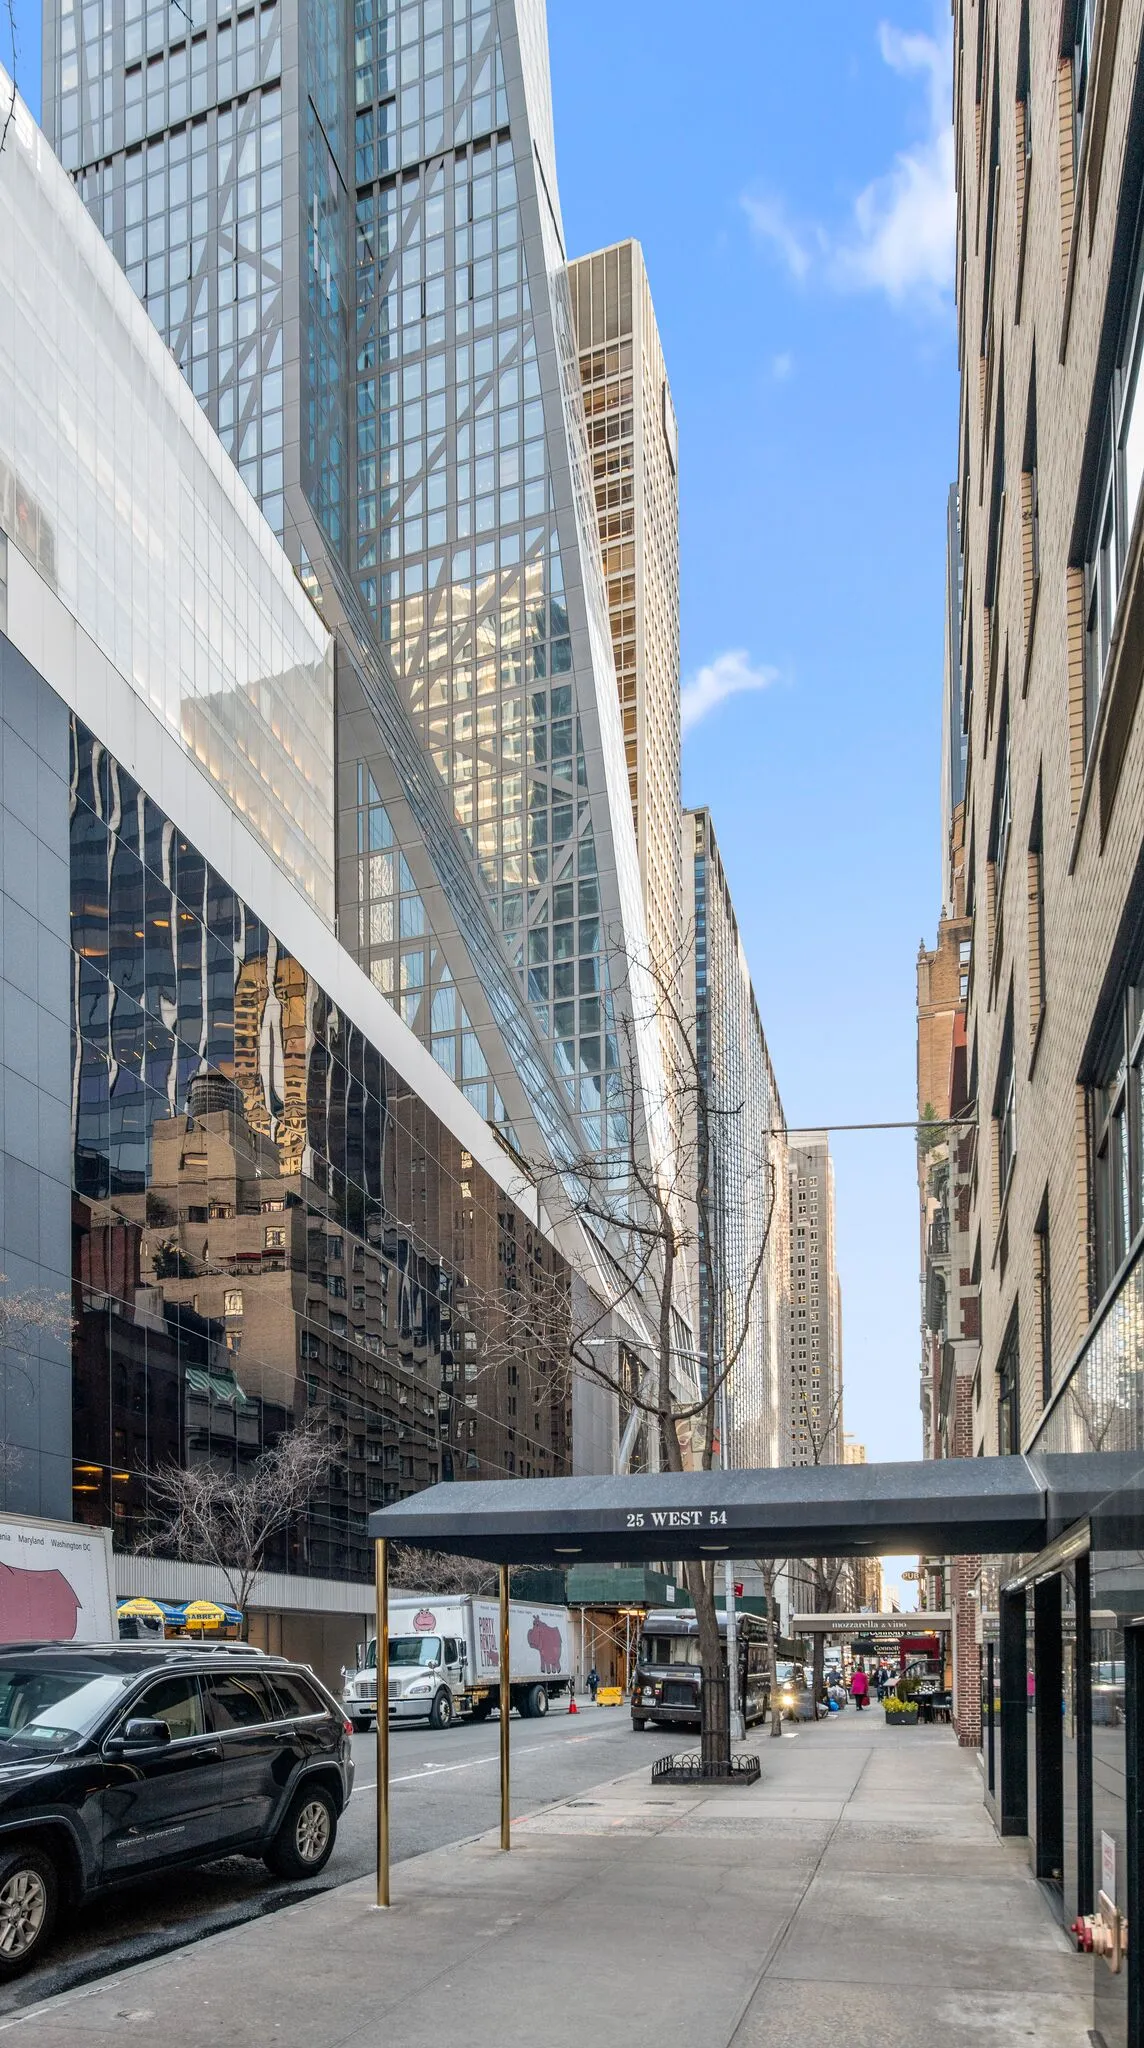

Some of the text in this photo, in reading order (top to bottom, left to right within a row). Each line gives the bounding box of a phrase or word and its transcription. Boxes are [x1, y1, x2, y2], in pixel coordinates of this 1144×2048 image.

[626, 1510, 728, 1527] 25 WEST 54
[18, 1534, 45, 1546] Maryland
[50, 1538, 82, 1551] Washington
[82, 1543, 91, 1551] DC
[832, 1620, 879, 1629] mozzarella
